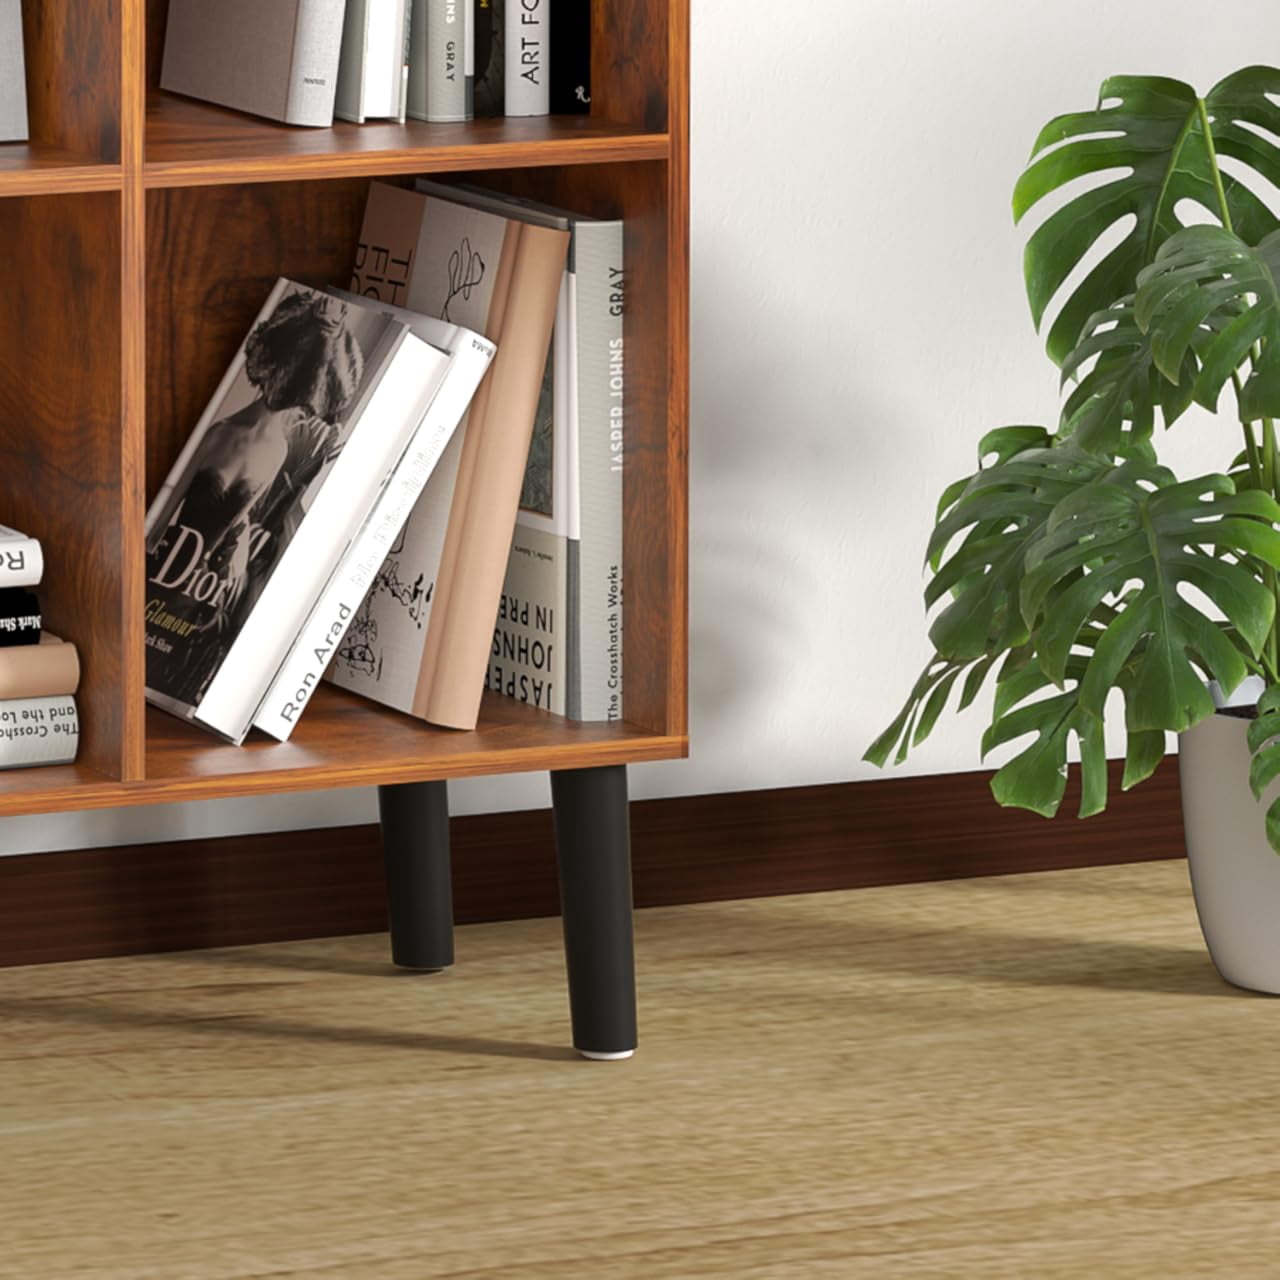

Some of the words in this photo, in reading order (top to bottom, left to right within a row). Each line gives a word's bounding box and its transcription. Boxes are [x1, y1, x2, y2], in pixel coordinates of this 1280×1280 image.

[445, 41, 456, 82] GRAY
[521, 37, 540, 85] ART
[609, 267, 624, 317] GRAY
[609, 337, 623, 398] JOHNS
[149, 525, 232, 607] Dior
[607, 565, 618, 608] Works
[17, 615, 41, 631] Mark
[535, 605, 553, 634] IN
[280, 672, 316, 723] Ron
[314, 602, 352, 665] Arad
[493, 628, 553, 673] JOHNS
[607, 613, 618, 689] Crosshatch
[21, 708, 44, 721] the
[49, 706, 75, 721] and
[53, 722, 79, 736] The
[608, 694, 619, 722] The
